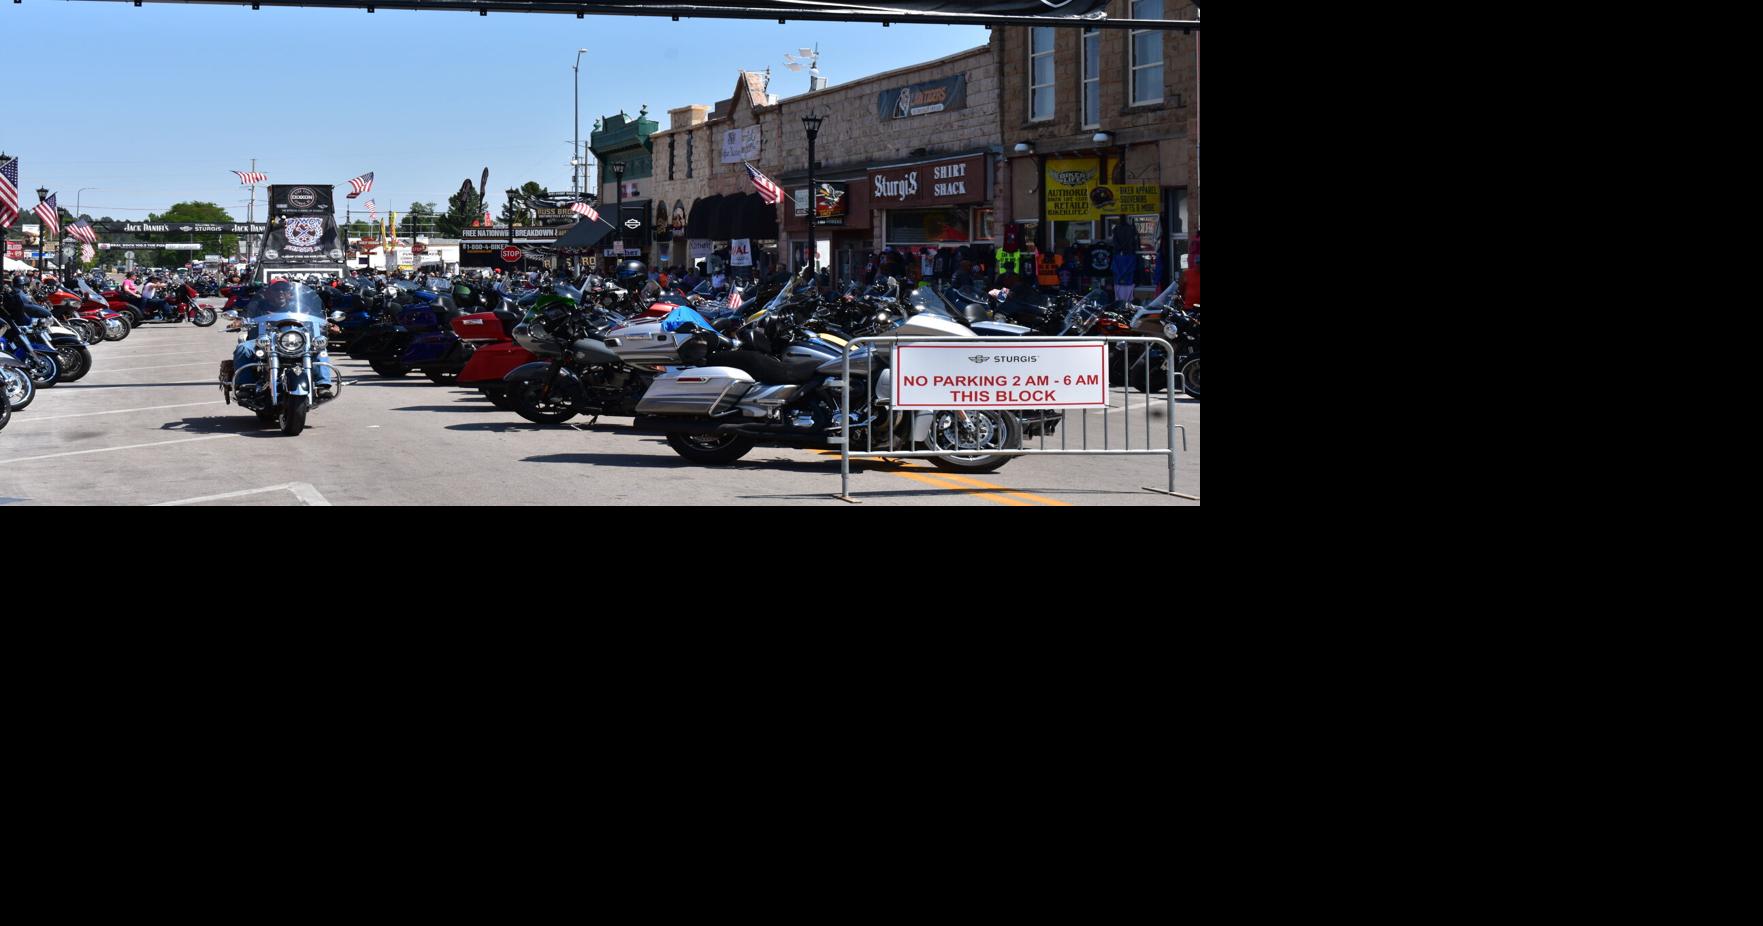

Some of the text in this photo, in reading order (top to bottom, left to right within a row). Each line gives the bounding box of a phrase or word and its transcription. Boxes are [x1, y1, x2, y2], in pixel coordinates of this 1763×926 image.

[934, 163, 967, 179] SHIRT
[934, 181, 967, 197] SHACK
[1048, 189, 1088, 197] AUTHORIZ
[124, 223, 142, 232] JACK
[231, 224, 249, 232] JACK
[462, 229, 477, 237] FREE
[515, 229, 554, 237] BREAKDOWN
[993, 355, 1038, 363] STURGIS
[903, 375, 928, 387] NO
[933, 375, 1007, 387] PARKING
[1012, 375, 1021, 387] 2
[1025, 375, 1050, 386] AM
[1063, 374, 1072, 386] 6
[1076, 374, 1099, 386] AM
[950, 389, 1057, 402] THIS BLOCK
